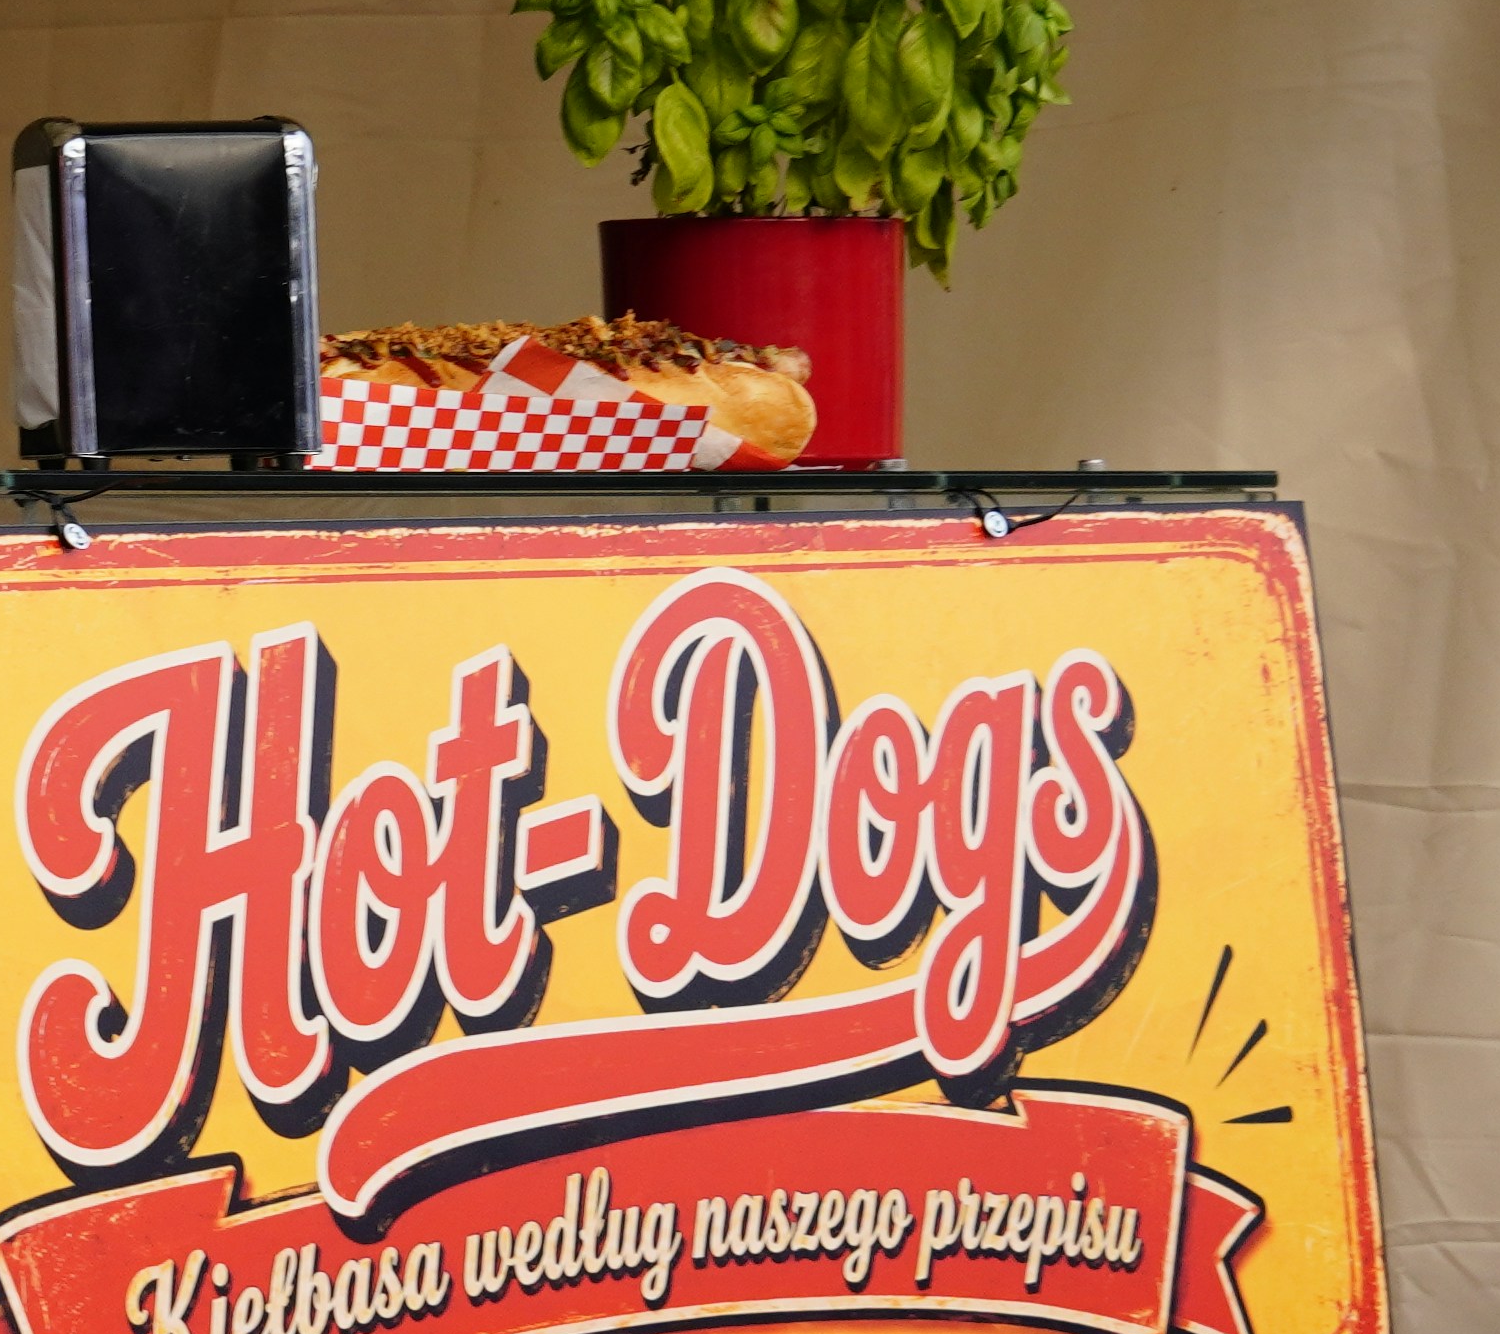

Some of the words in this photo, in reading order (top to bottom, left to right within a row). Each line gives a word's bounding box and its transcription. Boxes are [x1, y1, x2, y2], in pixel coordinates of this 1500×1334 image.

[15, 565, 1158, 1192] Hot-Dogs
[463, 1168, 686, 1313] według
[691, 1182, 916, 1279] naszego
[917, 1182, 1147, 1299] przepisu
